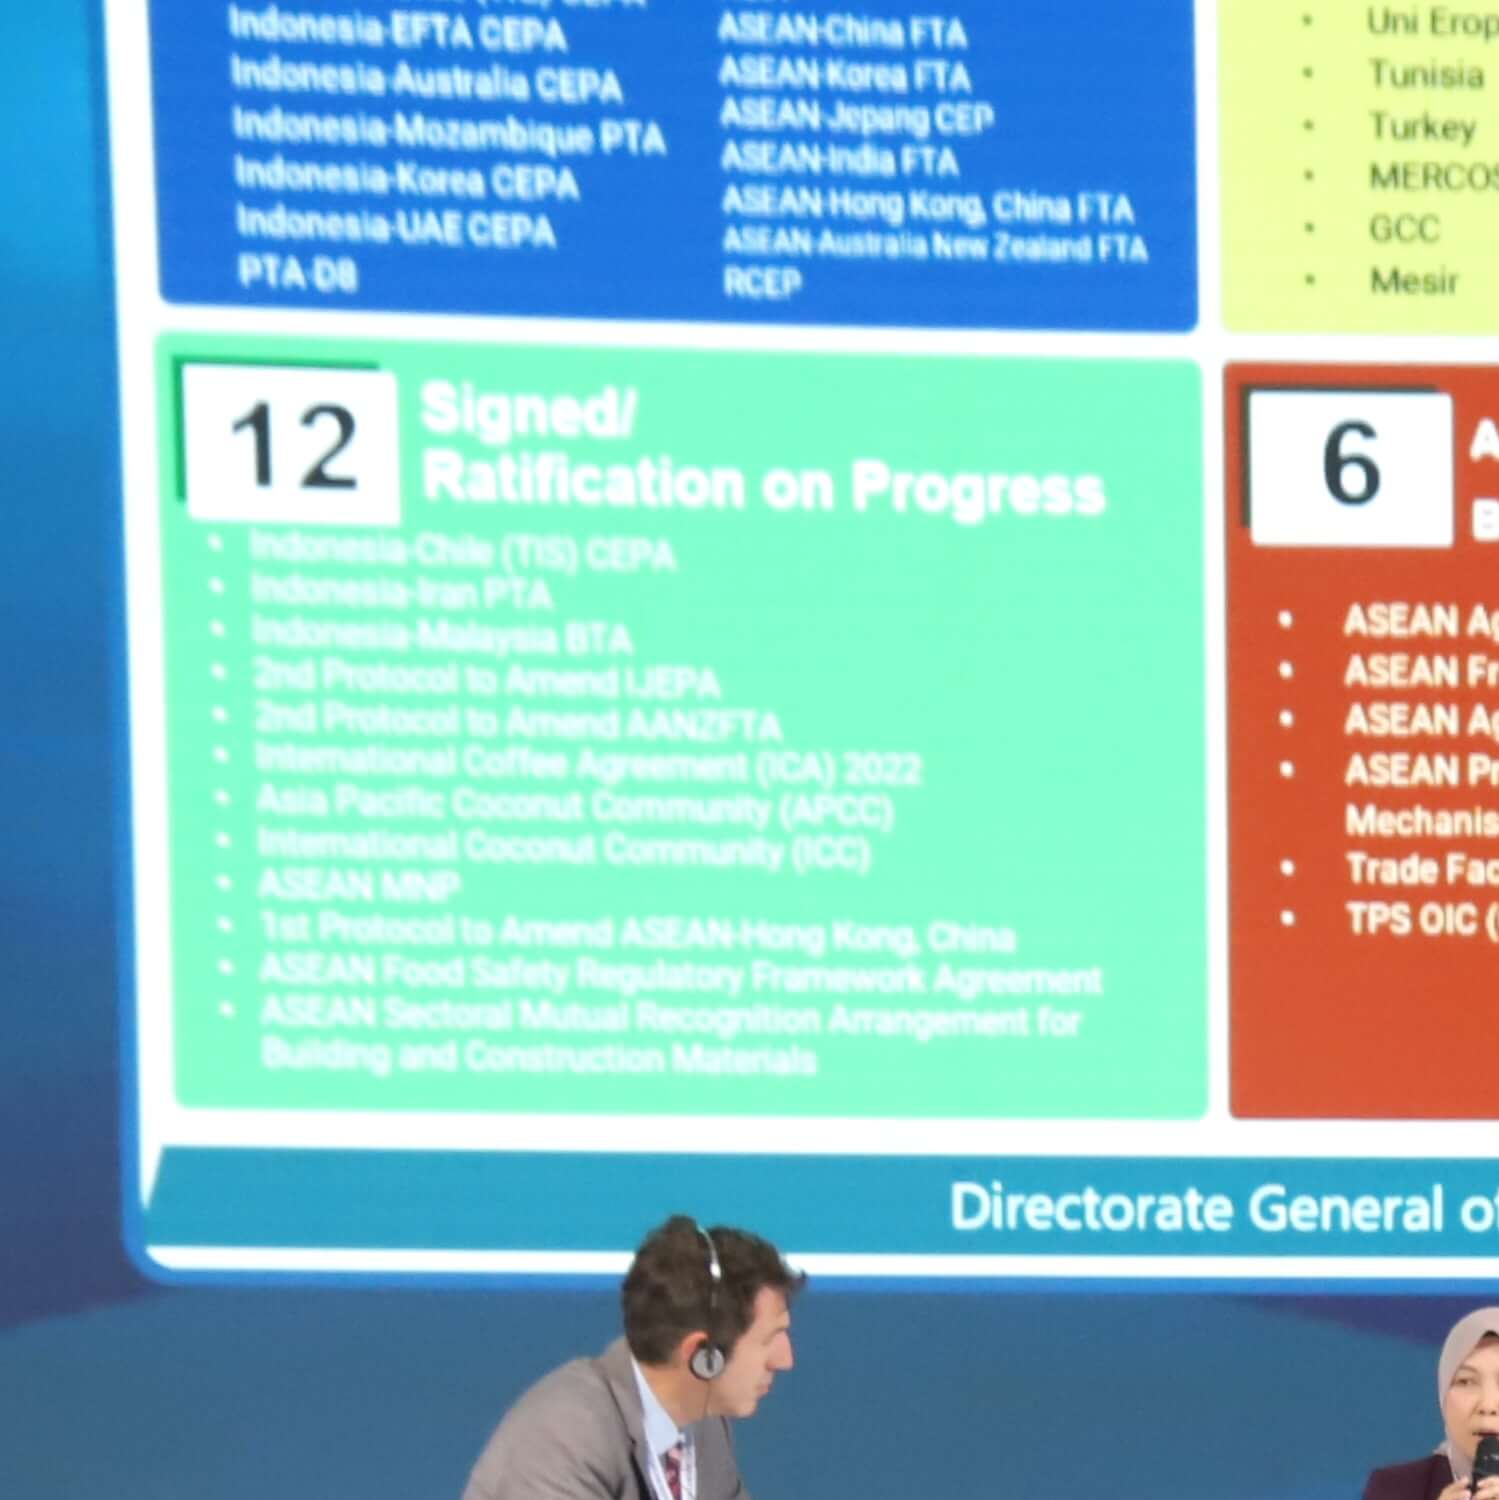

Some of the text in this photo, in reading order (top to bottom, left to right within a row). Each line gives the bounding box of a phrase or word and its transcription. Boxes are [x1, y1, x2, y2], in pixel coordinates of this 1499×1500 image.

[479, 15, 567, 52] CEPA
[910, 16, 967, 48] FTA
[1367, 7, 1418, 35] Uni
[535, 67, 623, 104] CEPA
[1370, 58, 1485, 90] Tunisia
[934, 102, 994, 136] CEP
[1371, 111, 1476, 147] Turkey
[901, 144, 959, 176] FTA
[491, 164, 579, 200] CEPA
[467, 211, 556, 248] CEPA
[1369, 213, 1440, 244] GCC
[724, 265, 802, 299] RCEP
[1371, 266, 1458, 295] Mesir
[420, 379, 639, 440] Signed/
[233, 402, 357, 489] 12
[1324, 421, 1380, 506] 6
[422, 448, 1107, 526] Ratification on Progress
[584, 536, 677, 572] CEPA
[1344, 602, 1459, 638] ASEAN
[1344, 653, 1459, 688] ASEAN
[1345, 702, 1459, 737] ASEAN
[256, 742, 923, 797] International Coffee Agreement (ICA) 2022
[1345, 752, 1460, 787] ASEAN
[1346, 851, 1440, 885] Trade
[1346, 901, 1412, 935] TPS
[1419, 902, 1478, 936] OIC
[259, 951, 1103, 1001] ASEAN Food Safety Regulatory Framework Agreement
[952, 1180, 1234, 1231] Directorate
[1249, 1184, 1443, 1232] General
